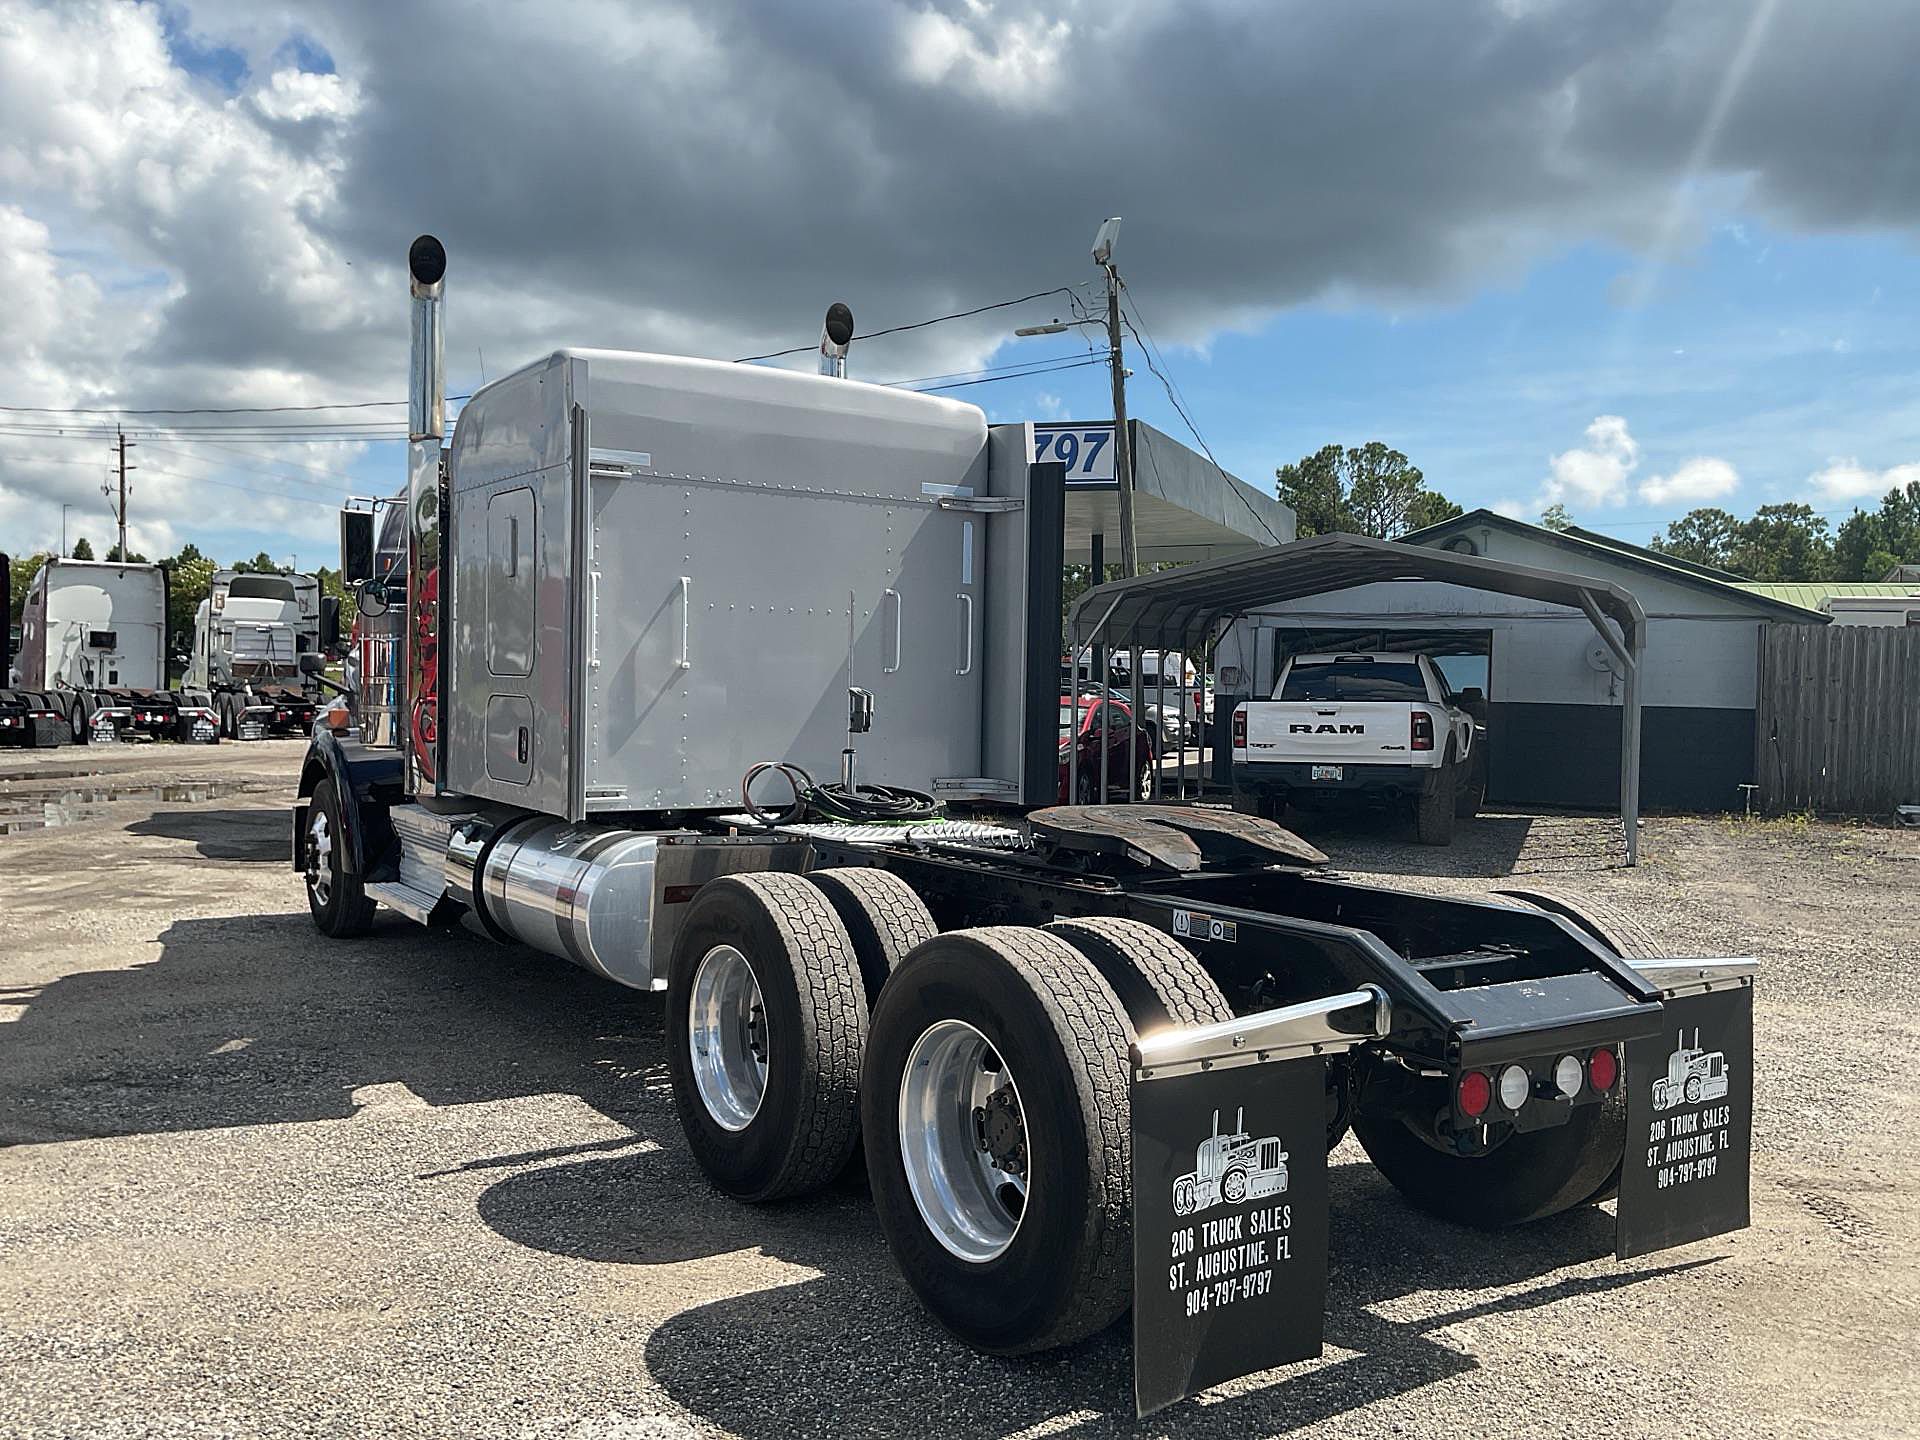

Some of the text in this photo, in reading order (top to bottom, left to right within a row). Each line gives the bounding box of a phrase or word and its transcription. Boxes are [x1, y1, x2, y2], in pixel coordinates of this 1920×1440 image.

[1289, 724, 1365, 734] RAM
[1650, 1105, 1730, 1143] 206 TRUCK SALES
[1647, 1146, 1661, 1167] ST.
[1719, 1129, 1730, 1149] FL
[1658, 1156, 1717, 1189] 904-797-9797
[1171, 1205, 1291, 1258] 206 TRUCK SALES
[1169, 1235, 1291, 1291] ST. AUGUSTINE, FL
[1186, 1269, 1273, 1317] 904-797-9797
